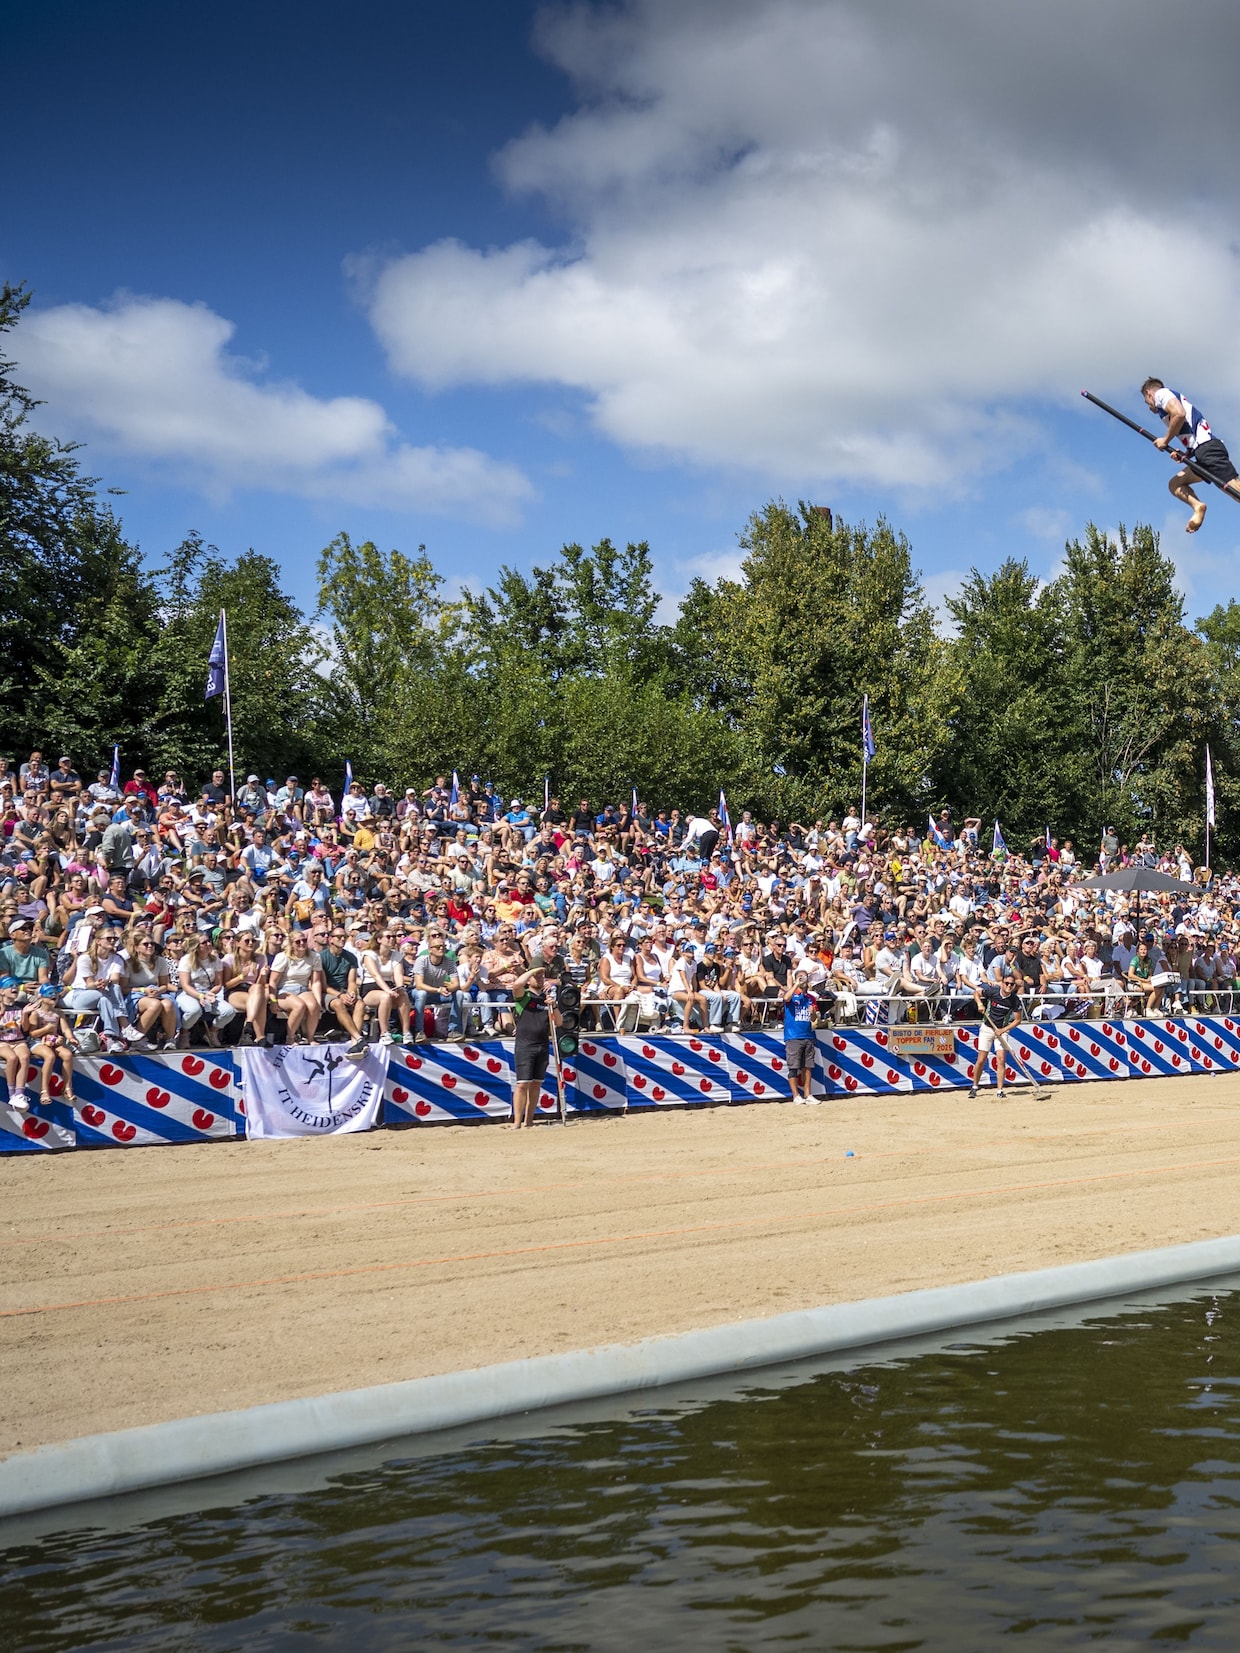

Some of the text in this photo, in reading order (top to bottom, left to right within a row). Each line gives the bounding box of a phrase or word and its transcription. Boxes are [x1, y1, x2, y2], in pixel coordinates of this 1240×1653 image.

[896, 1036, 922, 1044] TOPPER
[278, 1081, 373, 1128] IT HEIDENSKIP
